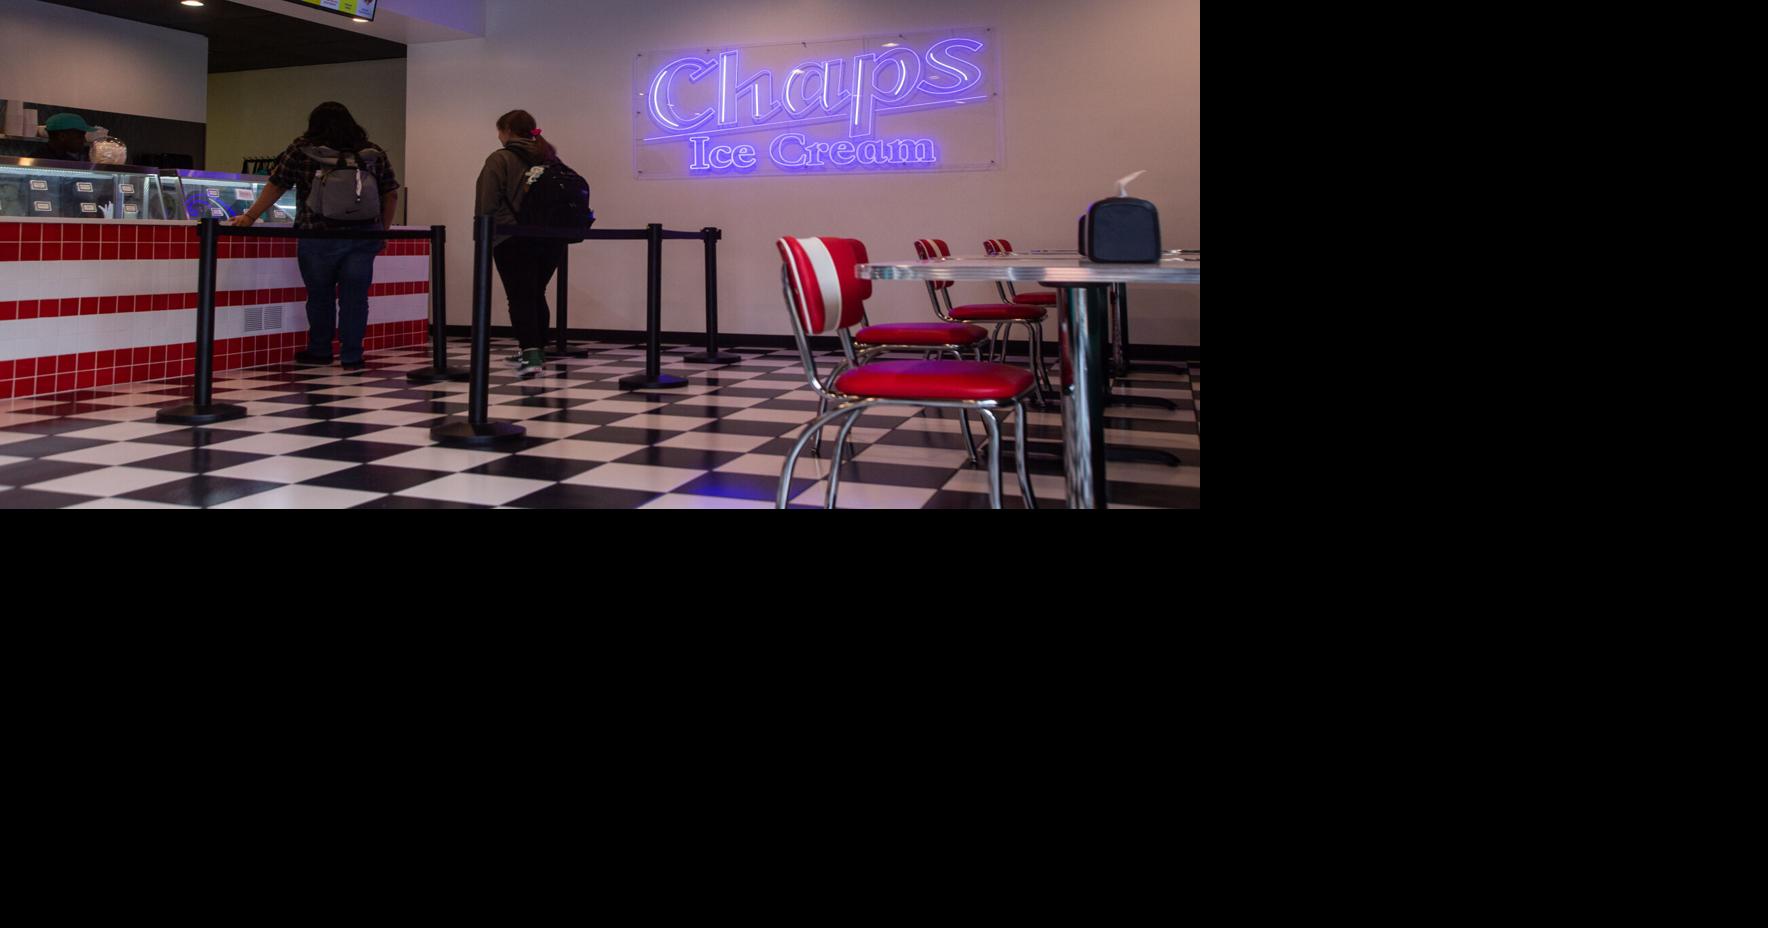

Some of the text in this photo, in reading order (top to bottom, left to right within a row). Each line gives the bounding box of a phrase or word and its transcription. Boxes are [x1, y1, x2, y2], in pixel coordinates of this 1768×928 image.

[648, 38, 984, 137] Chaps
[690, 133, 937, 170] Ice Cream
